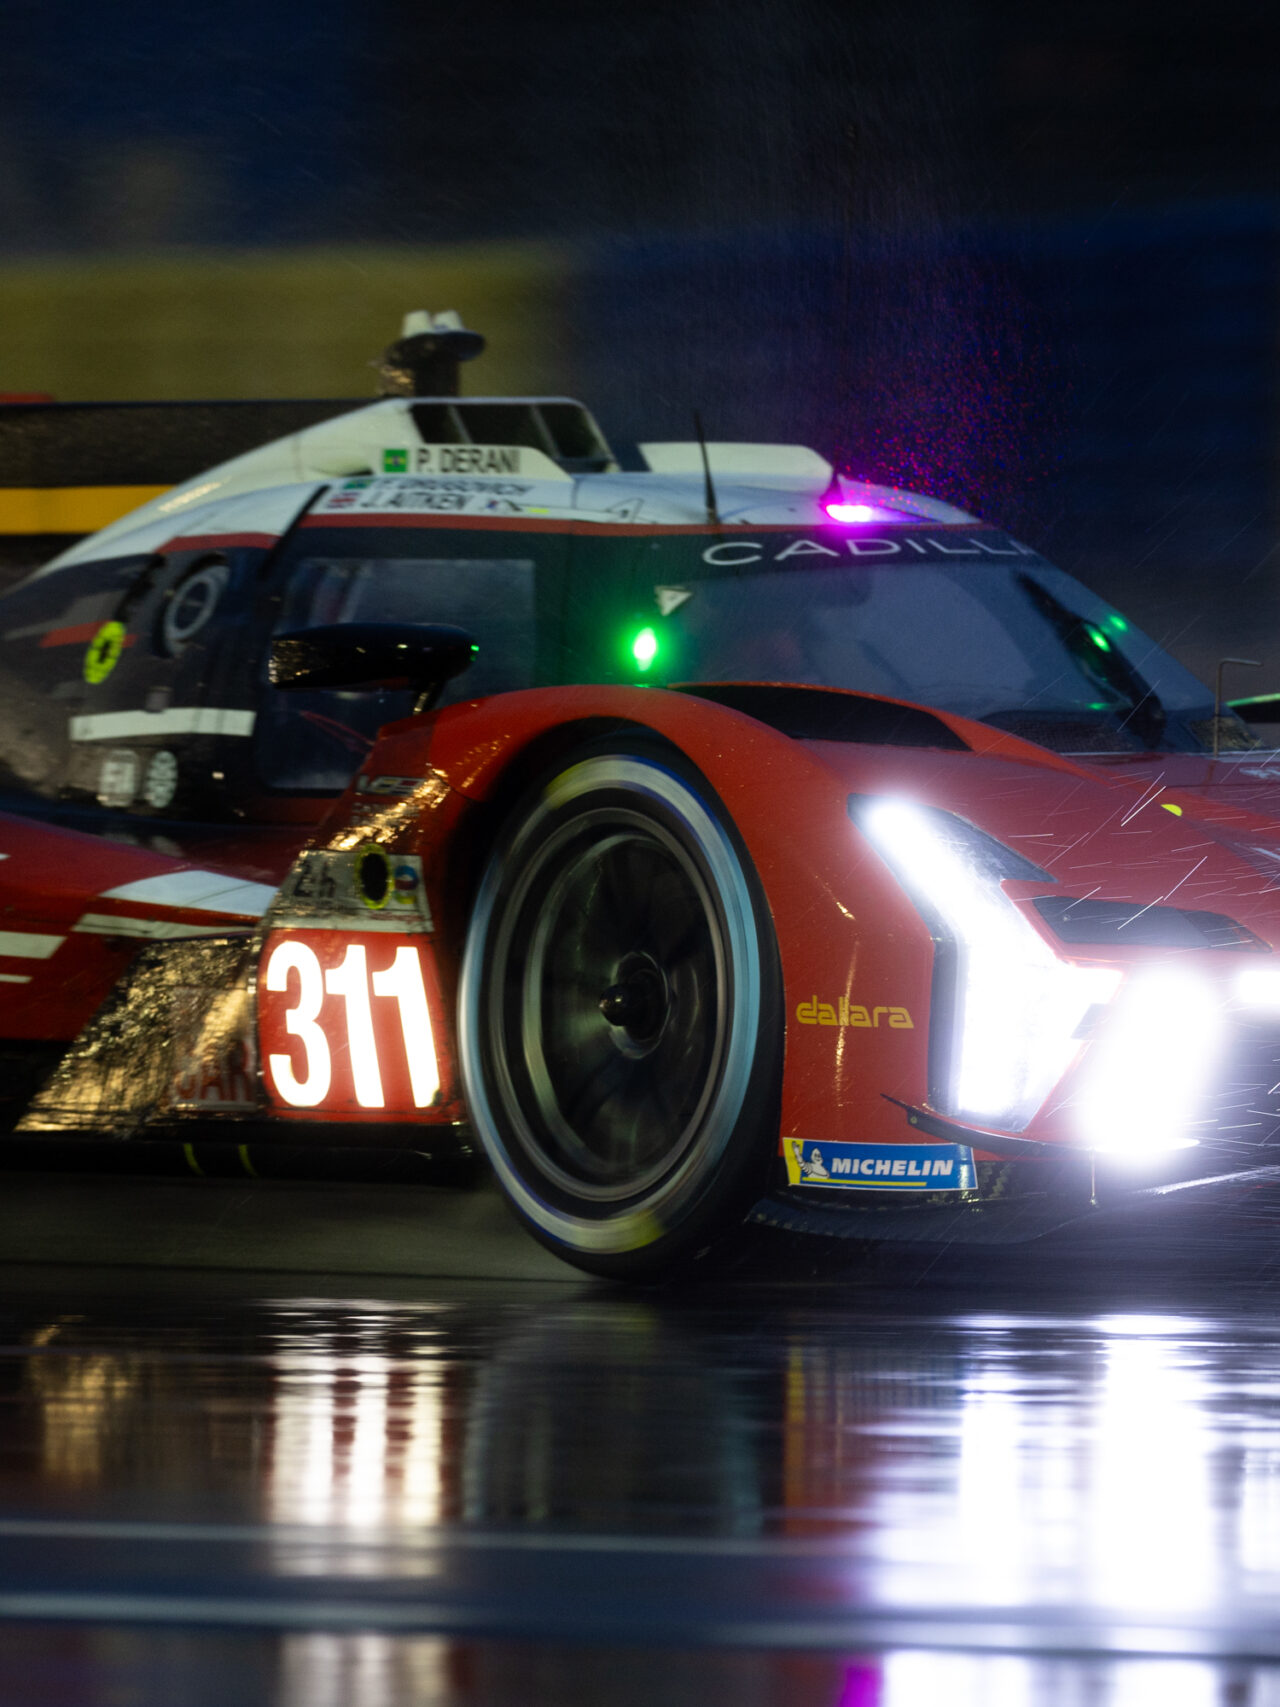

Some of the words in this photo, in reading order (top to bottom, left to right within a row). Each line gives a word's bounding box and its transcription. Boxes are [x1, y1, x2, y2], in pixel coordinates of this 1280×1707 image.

[440, 449, 521, 473] DERANI
[266, 940, 441, 1108] 311
[796, 995, 914, 1029] dallara
[831, 1158, 953, 1177] MICHELIN
